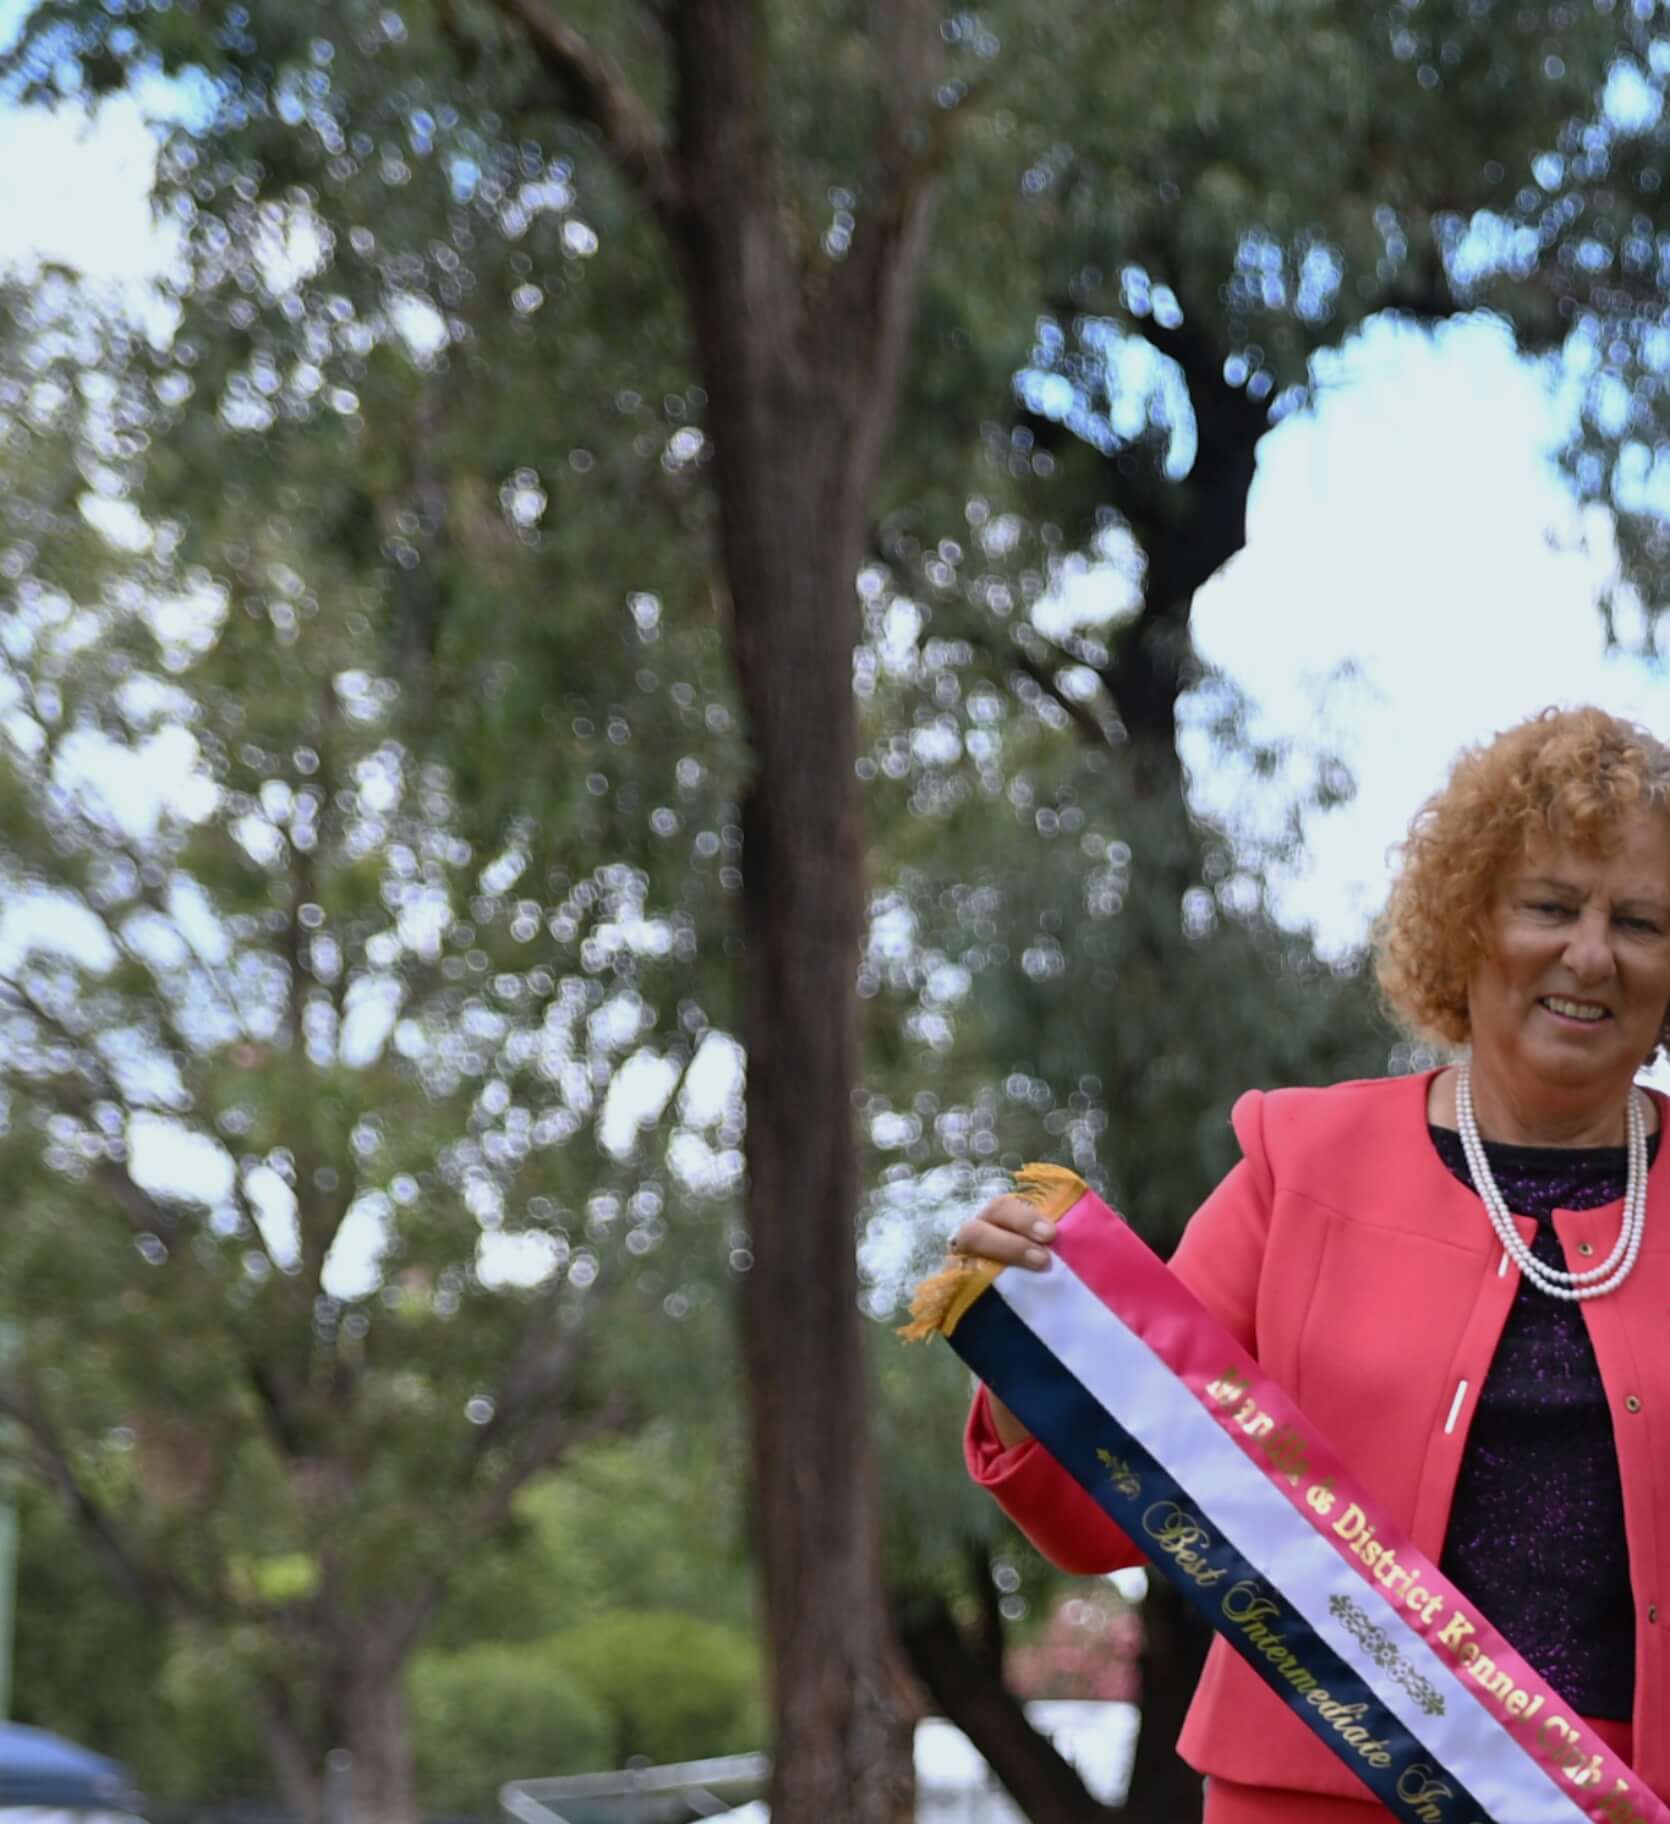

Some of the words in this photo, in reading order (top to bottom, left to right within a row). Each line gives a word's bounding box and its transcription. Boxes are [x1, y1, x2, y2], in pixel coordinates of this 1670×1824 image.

[1142, 1500, 1227, 1586] Best
[1222, 1580, 1392, 1769] Intermediate
[1306, 1475, 1336, 1515] &
[1332, 1502, 1444, 1625] District
[1437, 1611, 1545, 1720] Kennel
[1536, 1715, 1604, 1788] Club
